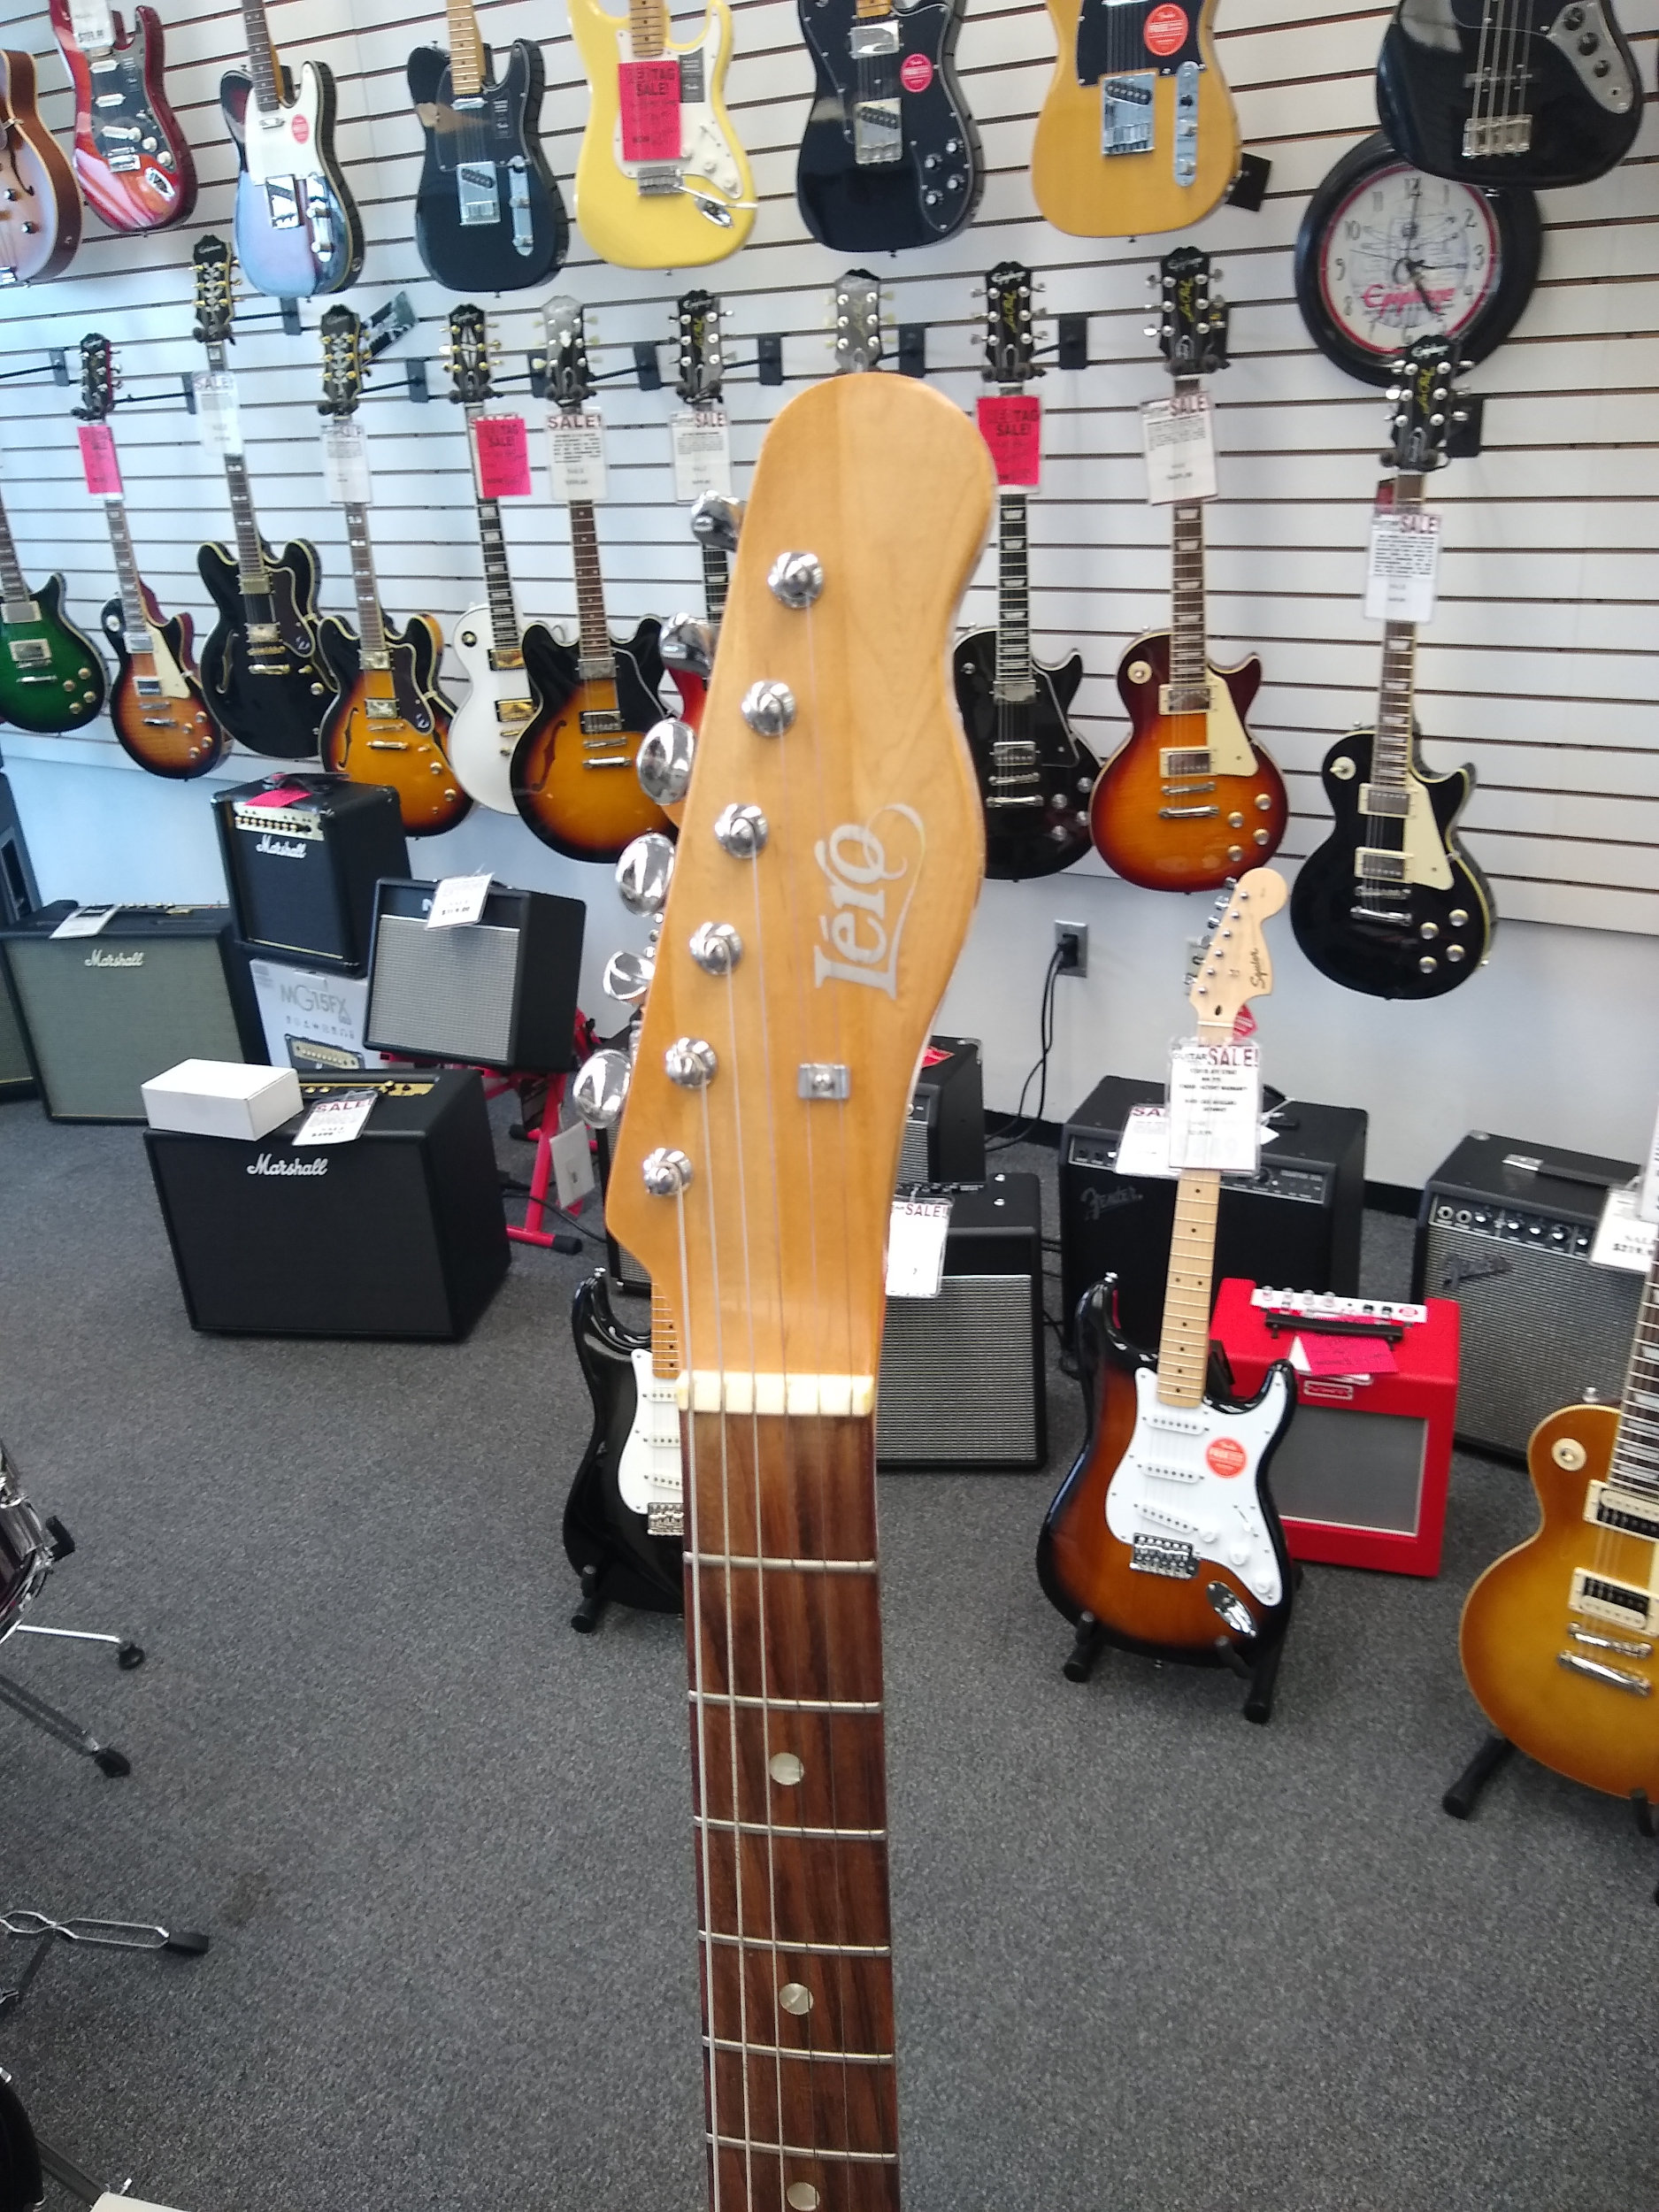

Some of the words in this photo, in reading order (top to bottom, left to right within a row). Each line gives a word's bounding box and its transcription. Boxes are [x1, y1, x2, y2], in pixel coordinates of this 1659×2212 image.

[548, 415, 602, 430] SALE!
[255, 833, 306, 859] Marshall
[84, 949, 144, 967] Marshall
[280, 983, 348, 1015] MG15FX
[1208, 1047, 1258, 1068] SALE!
[1132, 1107, 1161, 1118] SA
[246, 1153, 328, 1176] Marshall
[905, 1202, 950, 1218] SALE!
